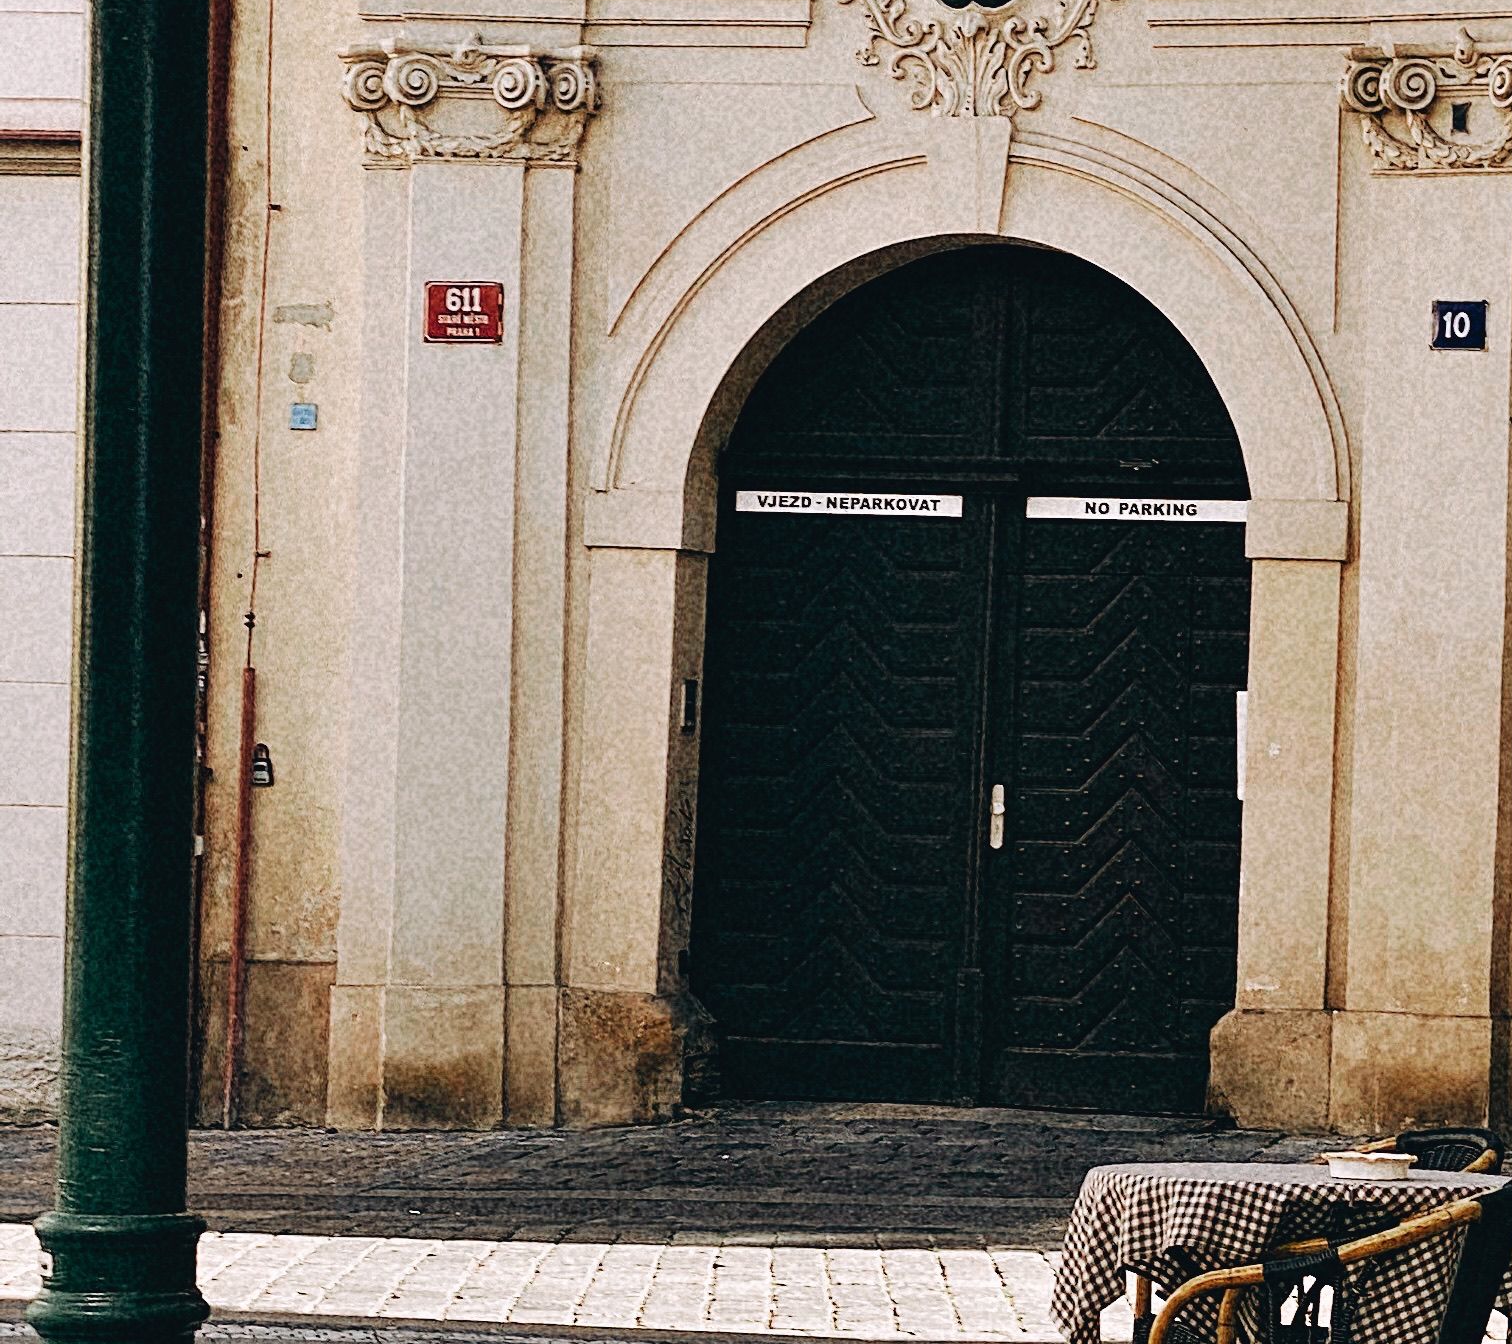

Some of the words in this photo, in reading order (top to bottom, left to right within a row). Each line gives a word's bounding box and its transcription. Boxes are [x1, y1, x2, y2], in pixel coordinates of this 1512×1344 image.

[445, 287, 482, 312] 611
[1442, 311, 1471, 338] 10
[757, 495, 812, 508] VJEZD
[826, 496, 941, 512] NEPARKOVAT
[1084, 501, 1110, 515] NO
[1119, 502, 1198, 517] PARKING
